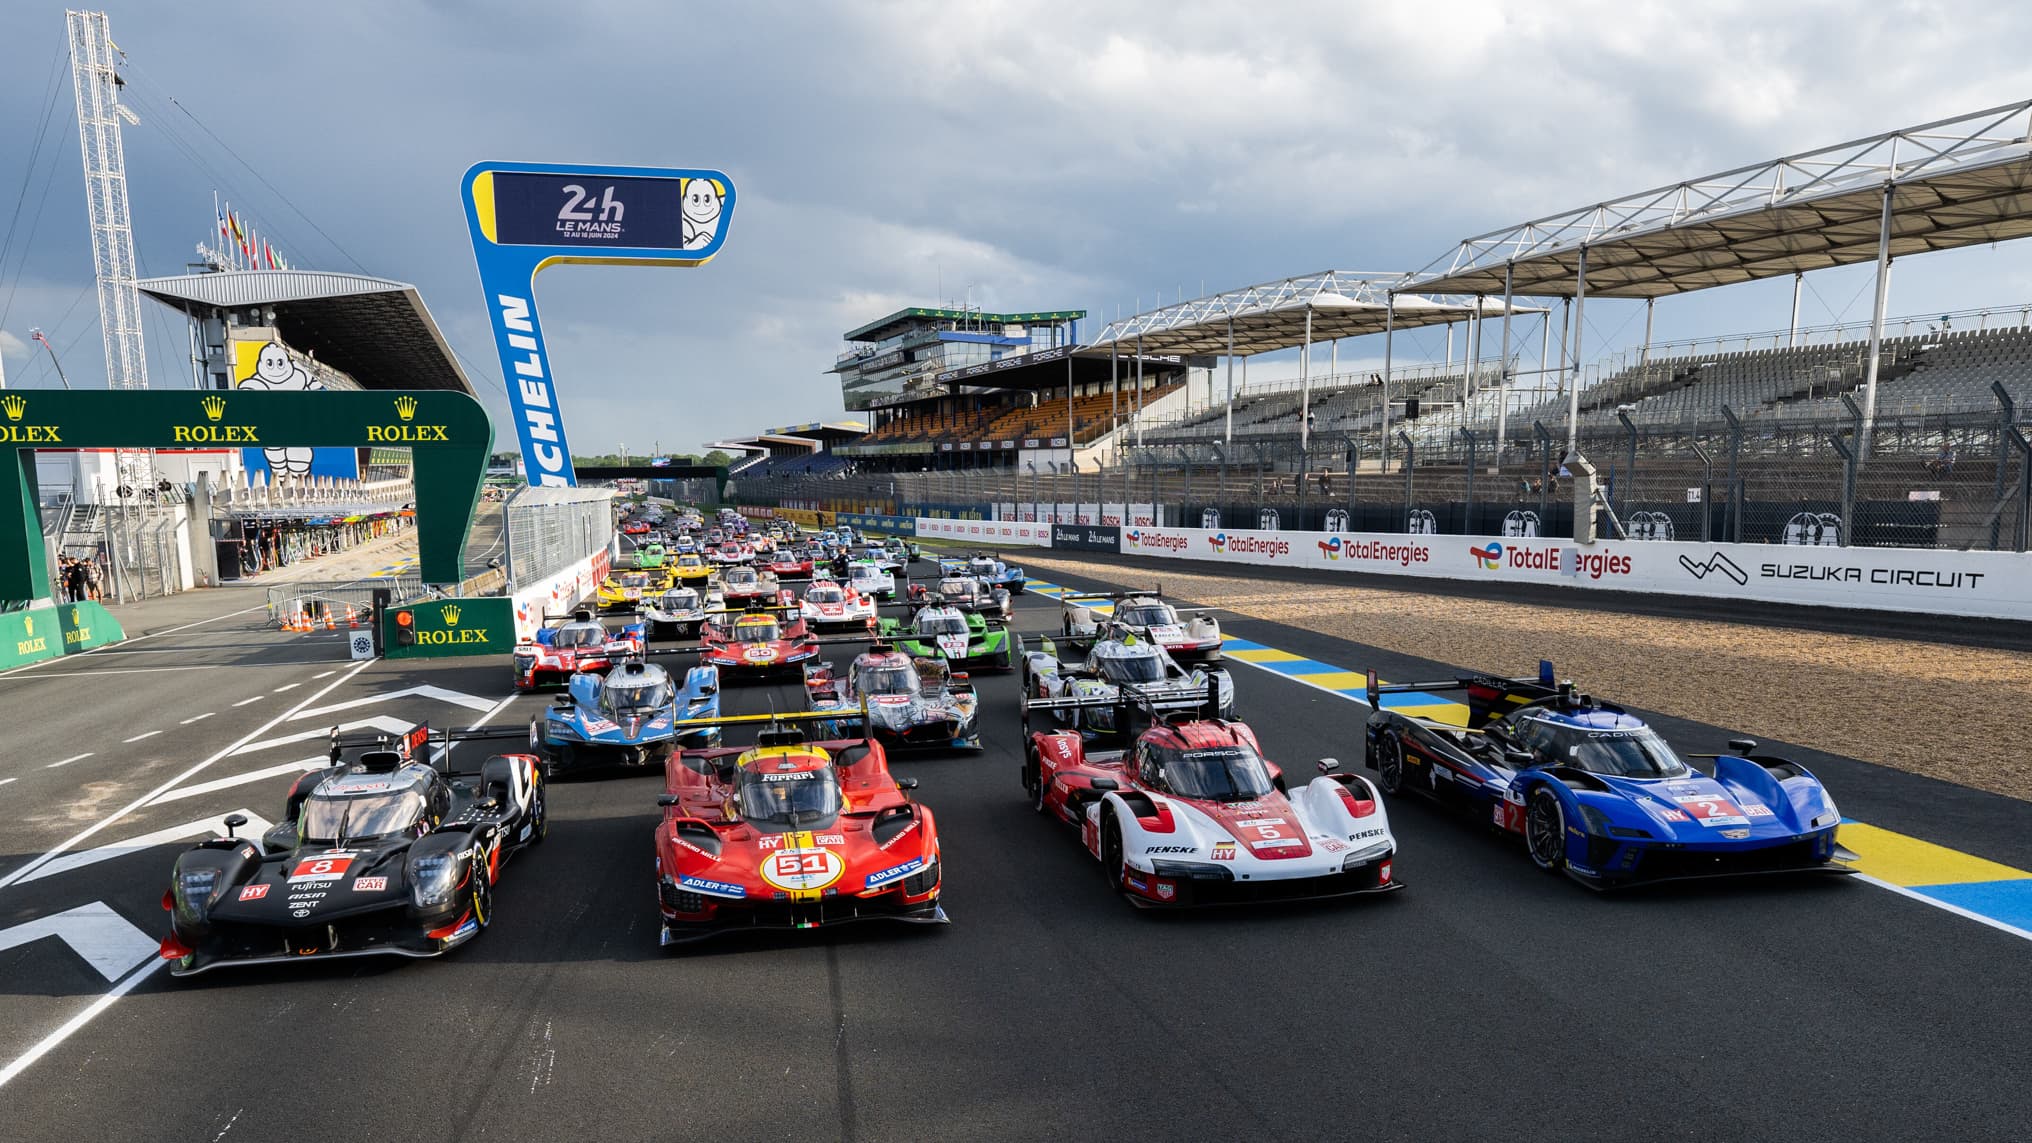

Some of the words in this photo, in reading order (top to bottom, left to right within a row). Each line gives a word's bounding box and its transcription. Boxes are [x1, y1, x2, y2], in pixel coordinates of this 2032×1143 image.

[556, 221, 575, 231] LE
[577, 221, 621, 232] MANS
[996, 357, 1022, 369] PORSCHE
[1032, 350, 1063, 362] PORSCHE
[498, 294, 572, 488] ICHELIN
[173, 426, 259, 442] ROLEX
[366, 425, 449, 441] ROLEX
[1102, 515, 1120, 526] BOSCH
[1069, 533, 1080, 542] MANS
[1102, 535, 1115, 544] MANS
[1140, 532, 1188, 552] TotalEnergies
[1227, 536, 1289, 558] TotalEnergies
[1343, 540, 1429, 567] TotalEnergies
[1506, 546, 1632, 579] TotalEergies
[1761, 564, 1862, 582] SUZUKA
[1871, 569, 1985, 588] CIRCUIT
[66, 627, 92, 645] ROLEX
[417, 629, 489, 645] ROLEX
[17, 637, 47, 655] ROLEX
[411, 726, 428, 751] DENSO
[761, 771, 815, 782] Ferrari
[1662, 810, 1687, 821] HY
[1698, 802, 1728, 817] 2
[1508, 805, 1521, 832] 2
[1257, 825, 1281, 839] 5
[1349, 828, 1385, 842] PENSKE
[758, 839, 780, 849] HY
[1144, 846, 1199, 855] PENSKE
[1212, 849, 1234, 859] HY
[310, 860, 334, 874] 8
[779, 855, 826, 874] 51
[869, 868, 902, 883] ADLER
[291, 881, 332, 891] FUJITSU
[356, 881, 384, 889] CAR
[683, 878, 720, 890] ADLER
[243, 886, 268, 898] HY
[288, 892, 327, 900] AISIN
[288, 901, 319, 909] ZENT
